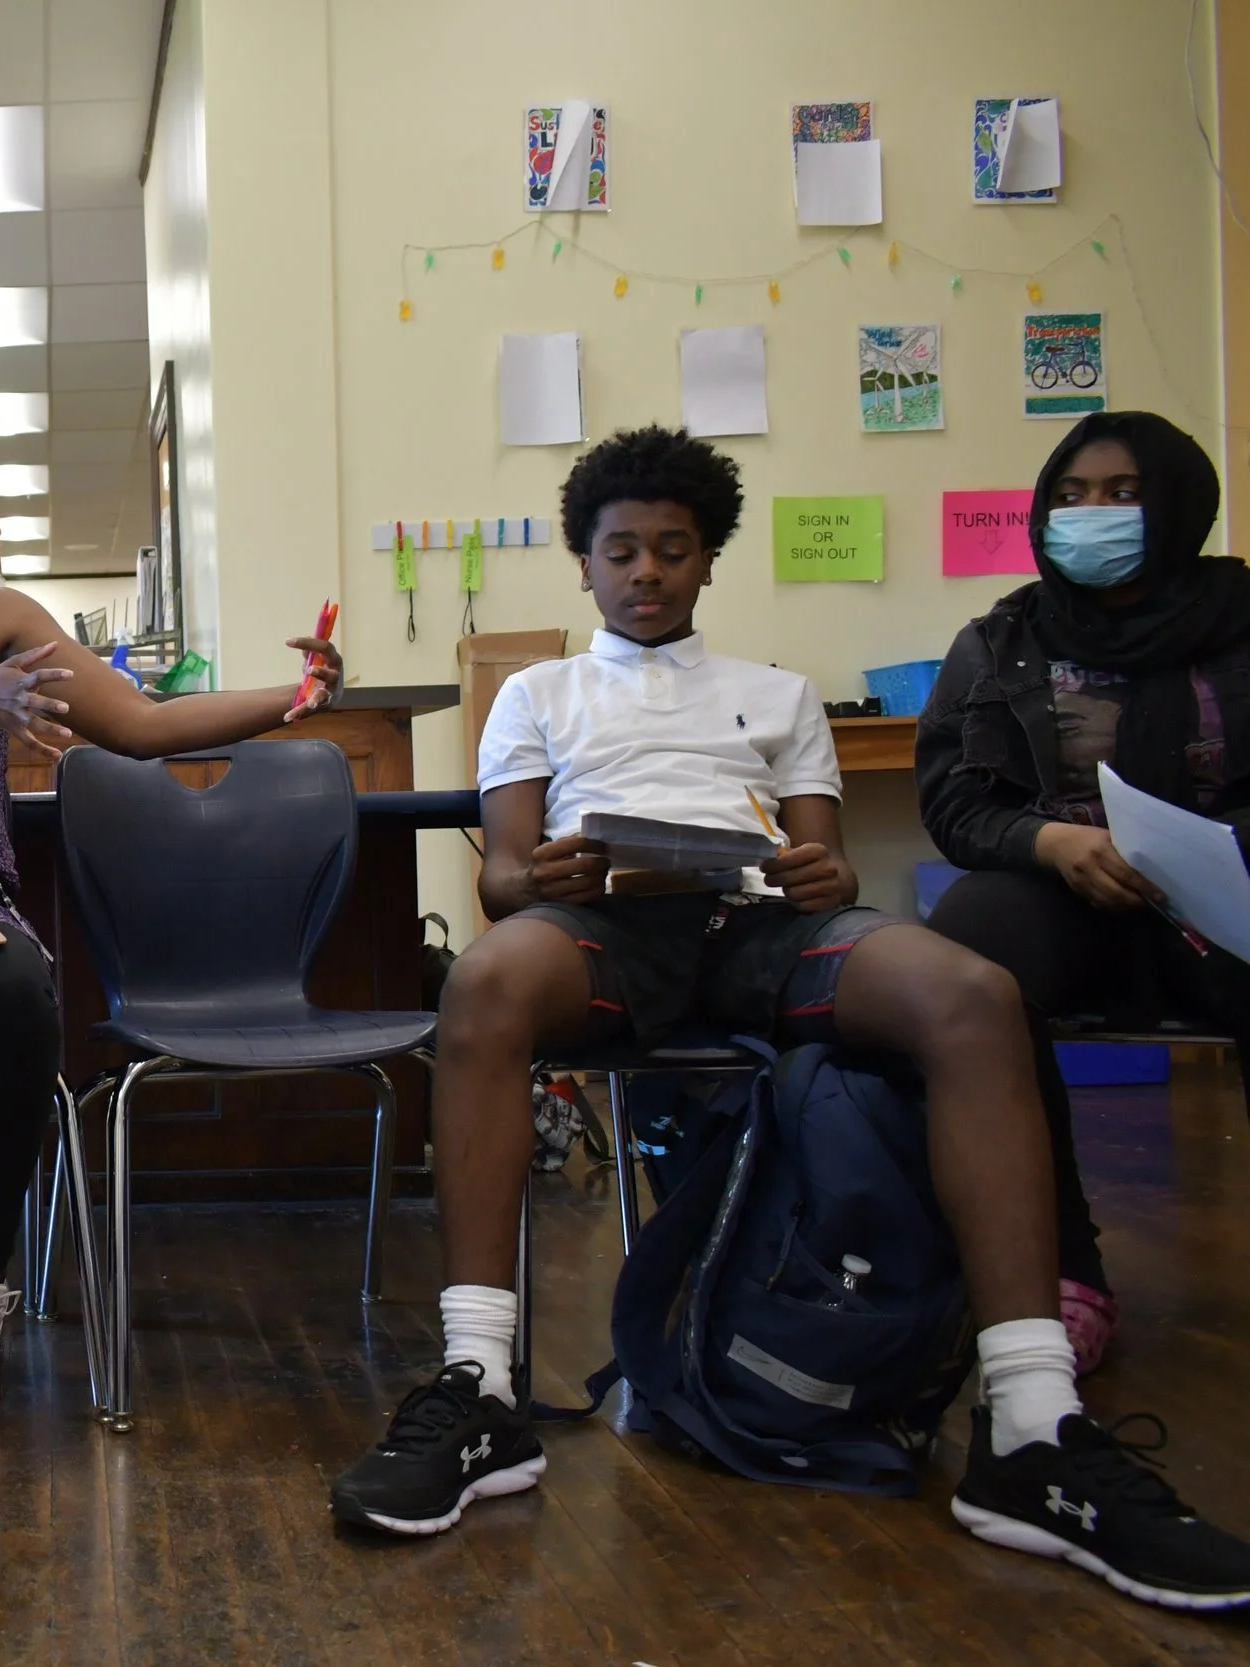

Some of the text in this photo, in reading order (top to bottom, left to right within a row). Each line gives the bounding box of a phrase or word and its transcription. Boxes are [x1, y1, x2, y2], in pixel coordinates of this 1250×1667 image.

[798, 515, 849, 526] SIGN IN
[953, 512, 1030, 527] TURN IN!
[813, 531, 833, 543] OR
[790, 547, 858, 560] SIGN OUT
